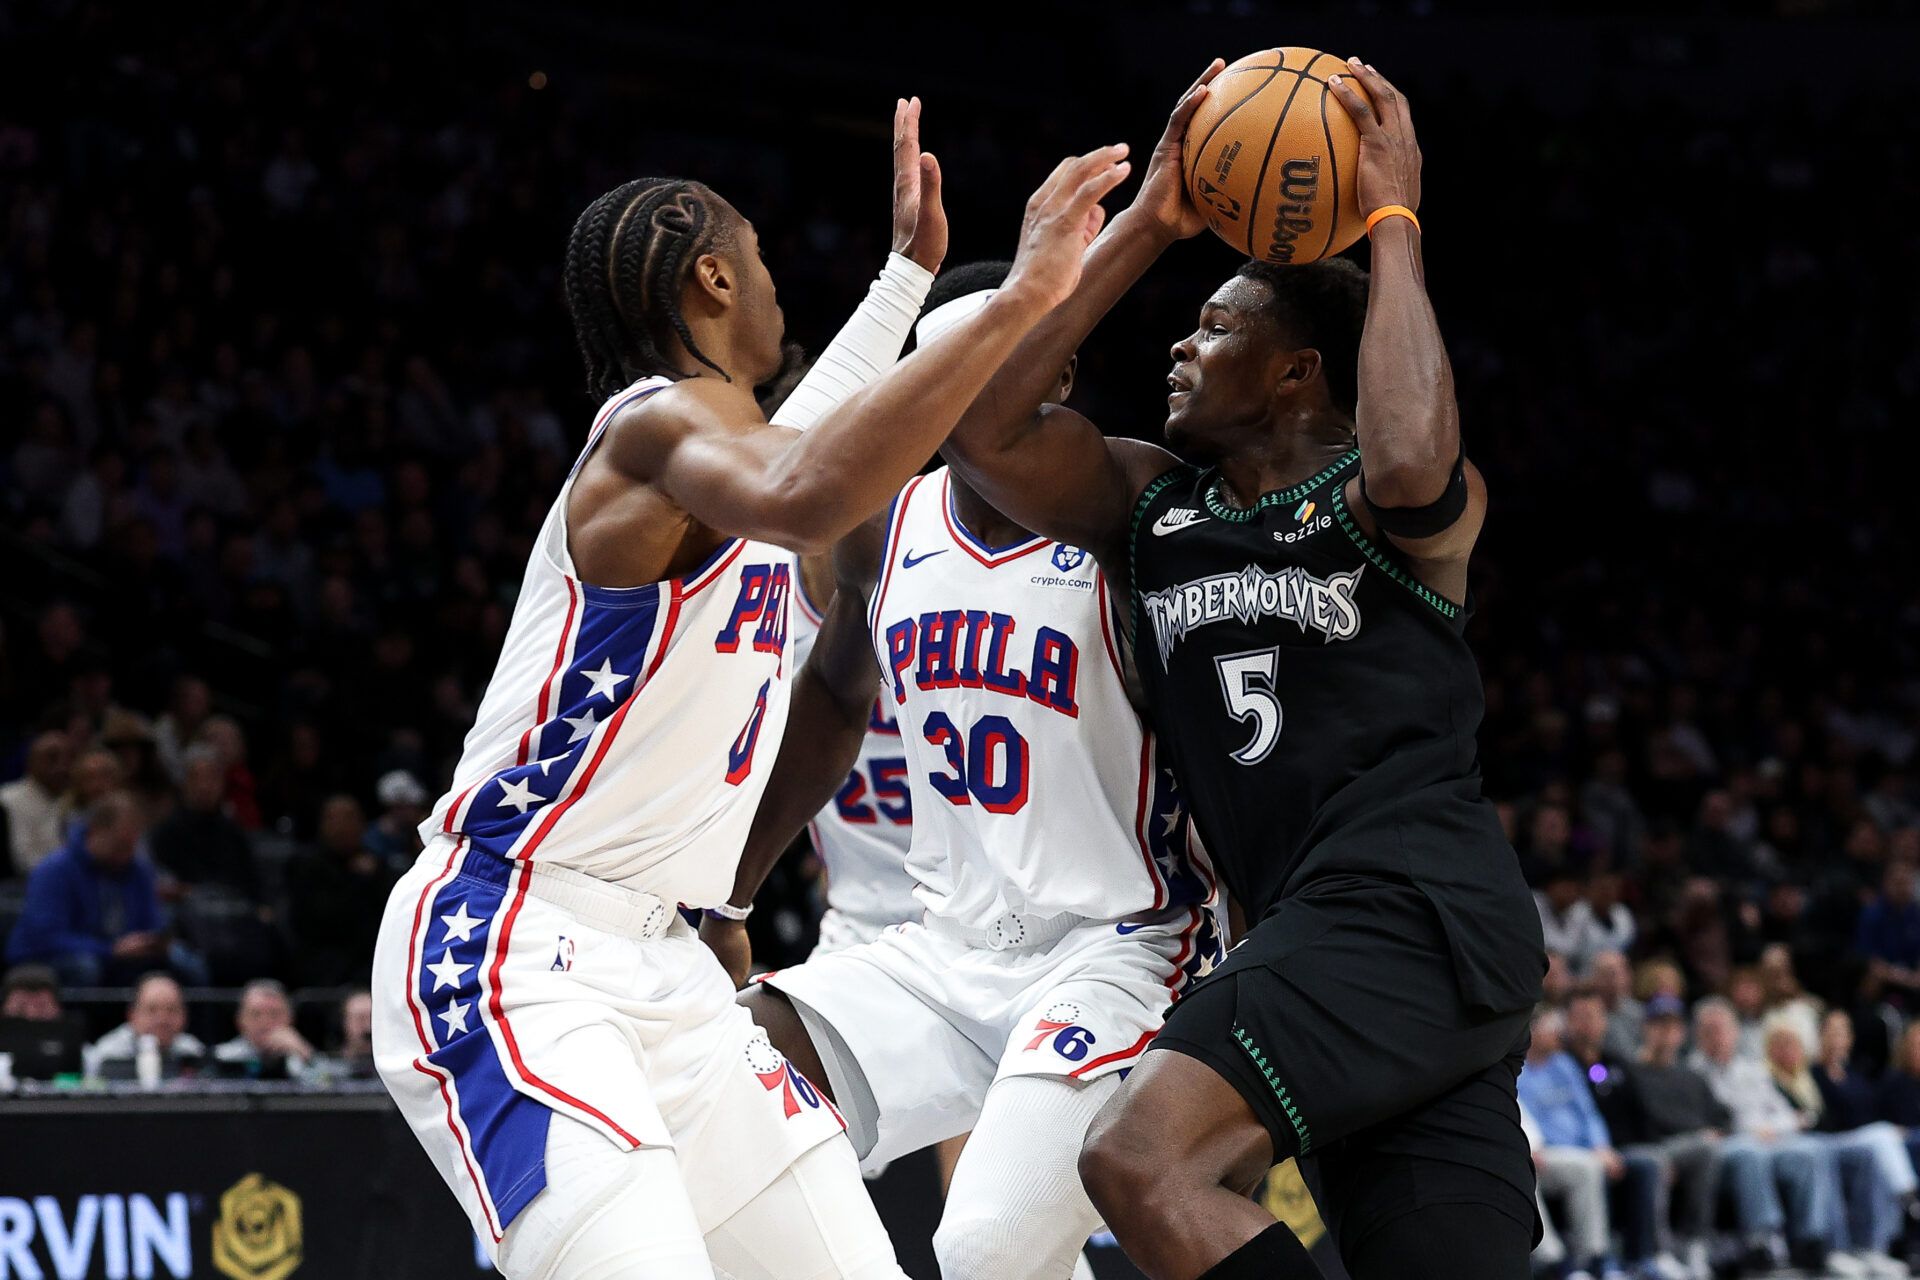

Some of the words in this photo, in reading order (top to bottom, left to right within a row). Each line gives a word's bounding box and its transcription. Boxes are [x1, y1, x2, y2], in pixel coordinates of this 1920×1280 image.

[1163, 507, 1200, 525] NIKE
[1273, 515, 1332, 543] sezzle
[1031, 576, 1093, 589] crypto.com
[1139, 563, 1366, 675] TIMBERWOLVES
[886, 609, 1079, 720] PHILA
[725, 677, 767, 787] 0
[1213, 645, 1283, 766] 5
[835, 757, 913, 826] 25
[923, 711, 1030, 815] 30
[1022, 1018, 1096, 1062] 76
[755, 1059, 820, 1120] 76
[0, 1191, 193, 1280] RVIN
